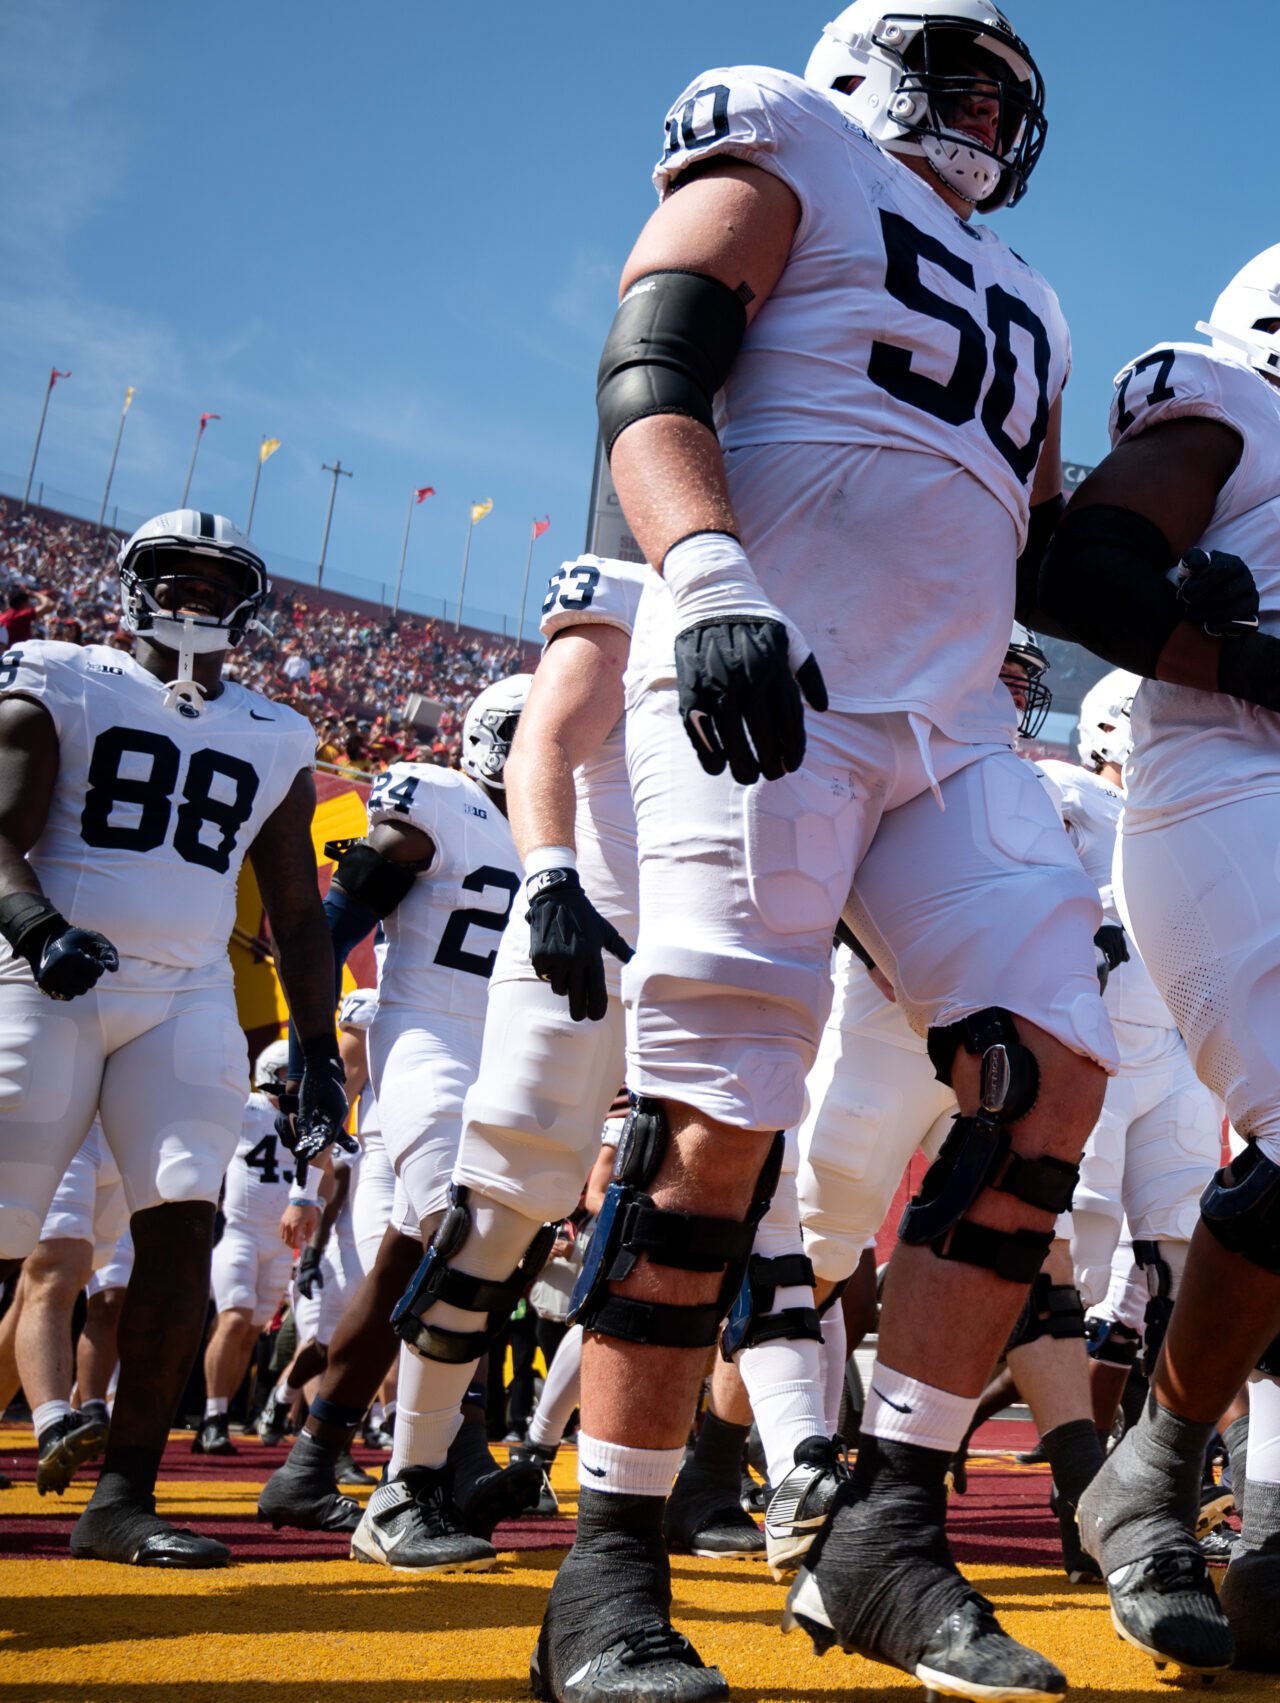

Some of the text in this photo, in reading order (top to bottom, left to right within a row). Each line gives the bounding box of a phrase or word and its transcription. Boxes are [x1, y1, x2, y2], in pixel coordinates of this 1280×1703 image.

[867, 207, 1051, 485] 50
[1116, 349, 1176, 434] 77
[80, 726, 260, 874] 88
[369, 772, 420, 814] 24
[244, 1134, 298, 1184] 4
